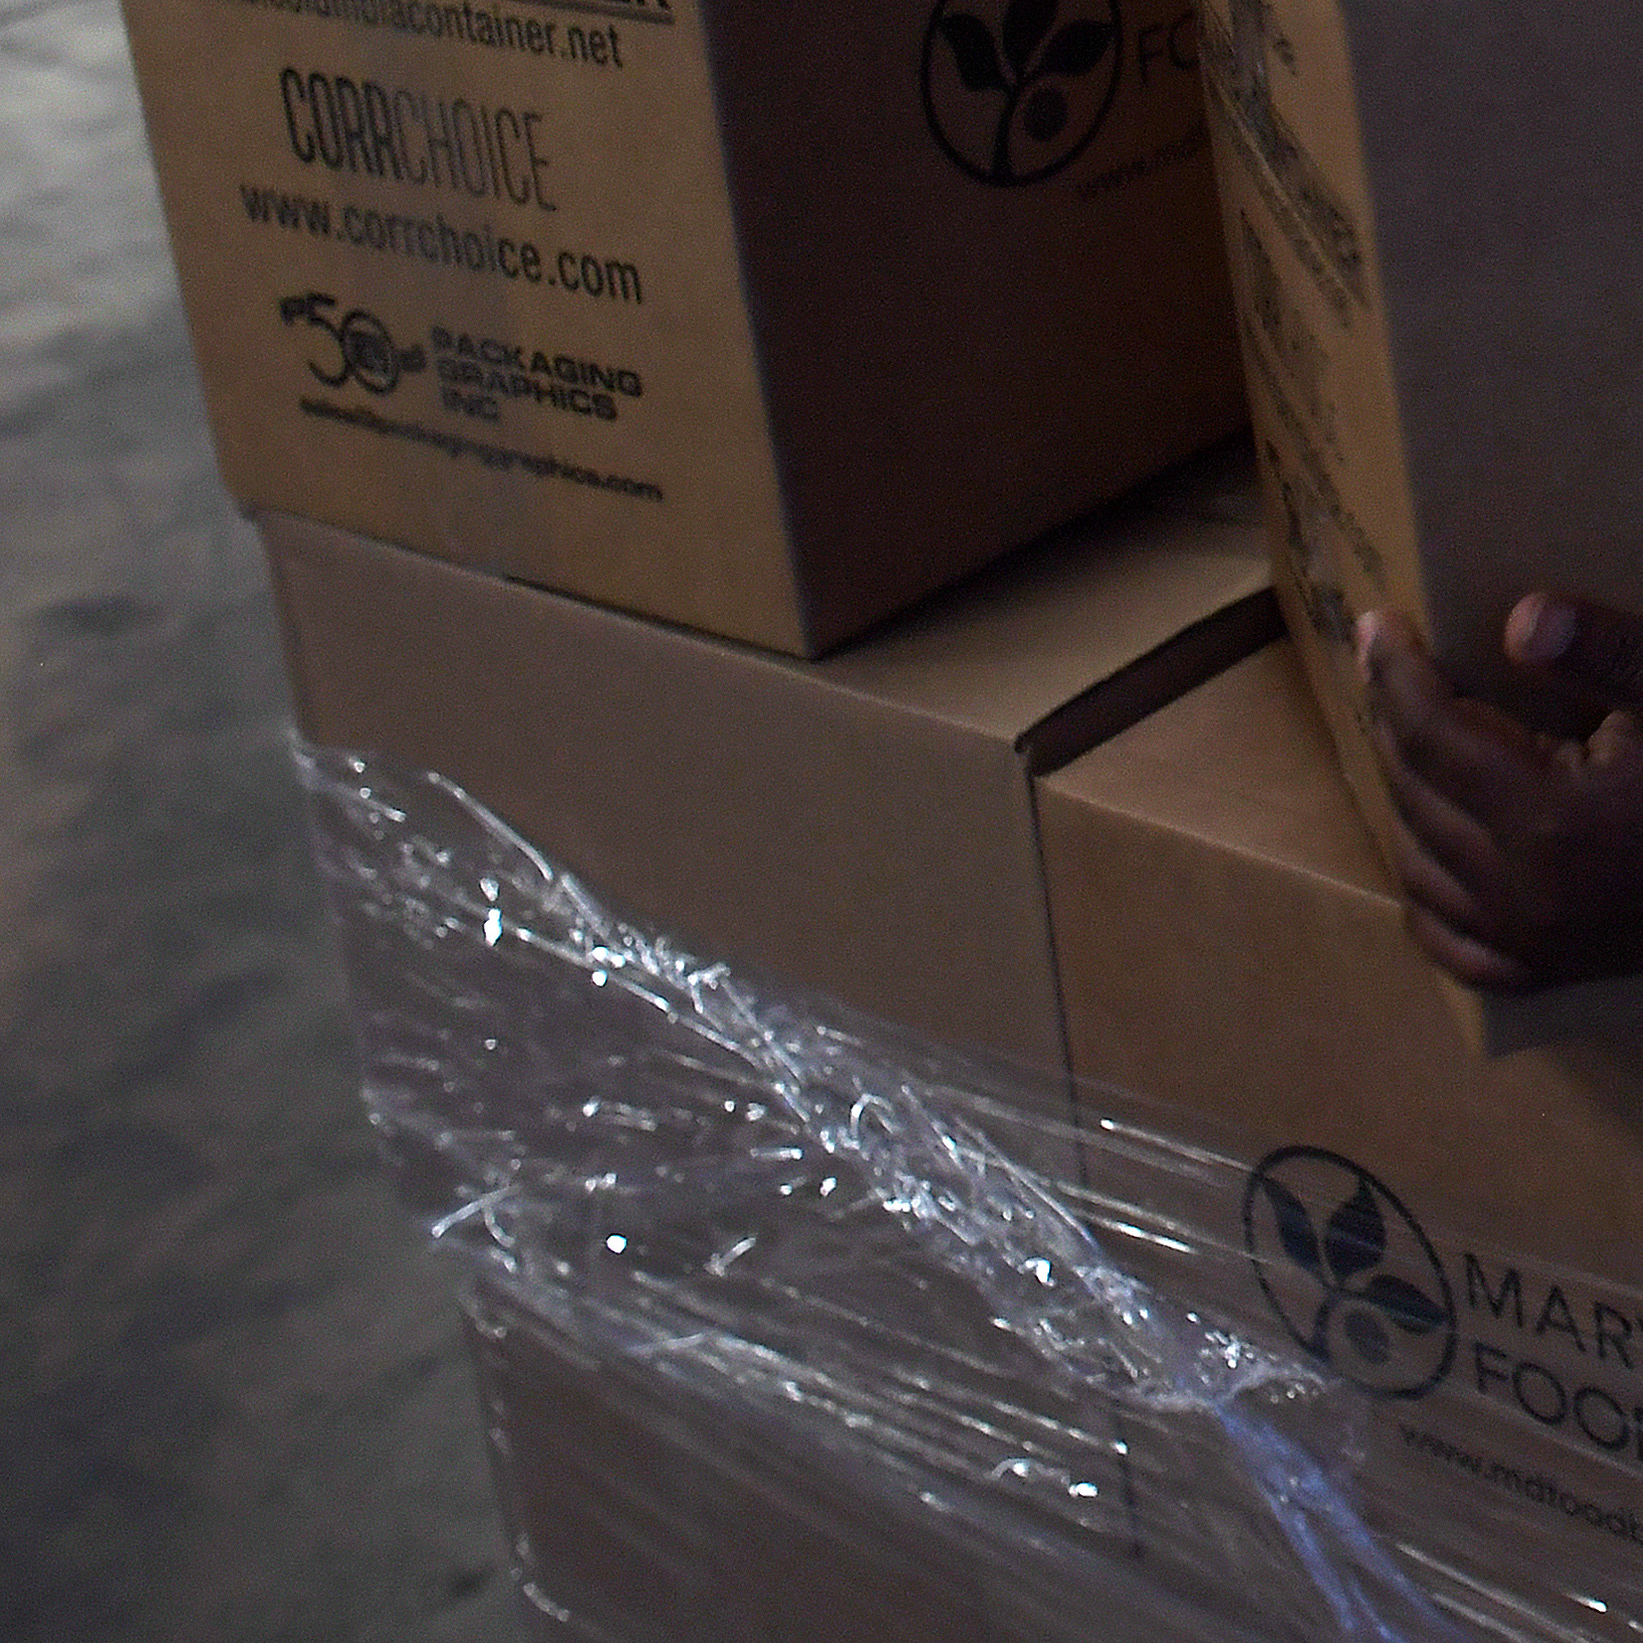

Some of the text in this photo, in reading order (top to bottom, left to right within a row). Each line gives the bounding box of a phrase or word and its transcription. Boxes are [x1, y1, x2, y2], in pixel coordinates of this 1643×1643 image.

[280, 67, 557, 212] CORRCHOICE
[240, 185, 643, 305] www.corrchoice.com
[431, 325, 643, 397] PACKAGING
[436, 358, 618, 421] GRAPHICS
